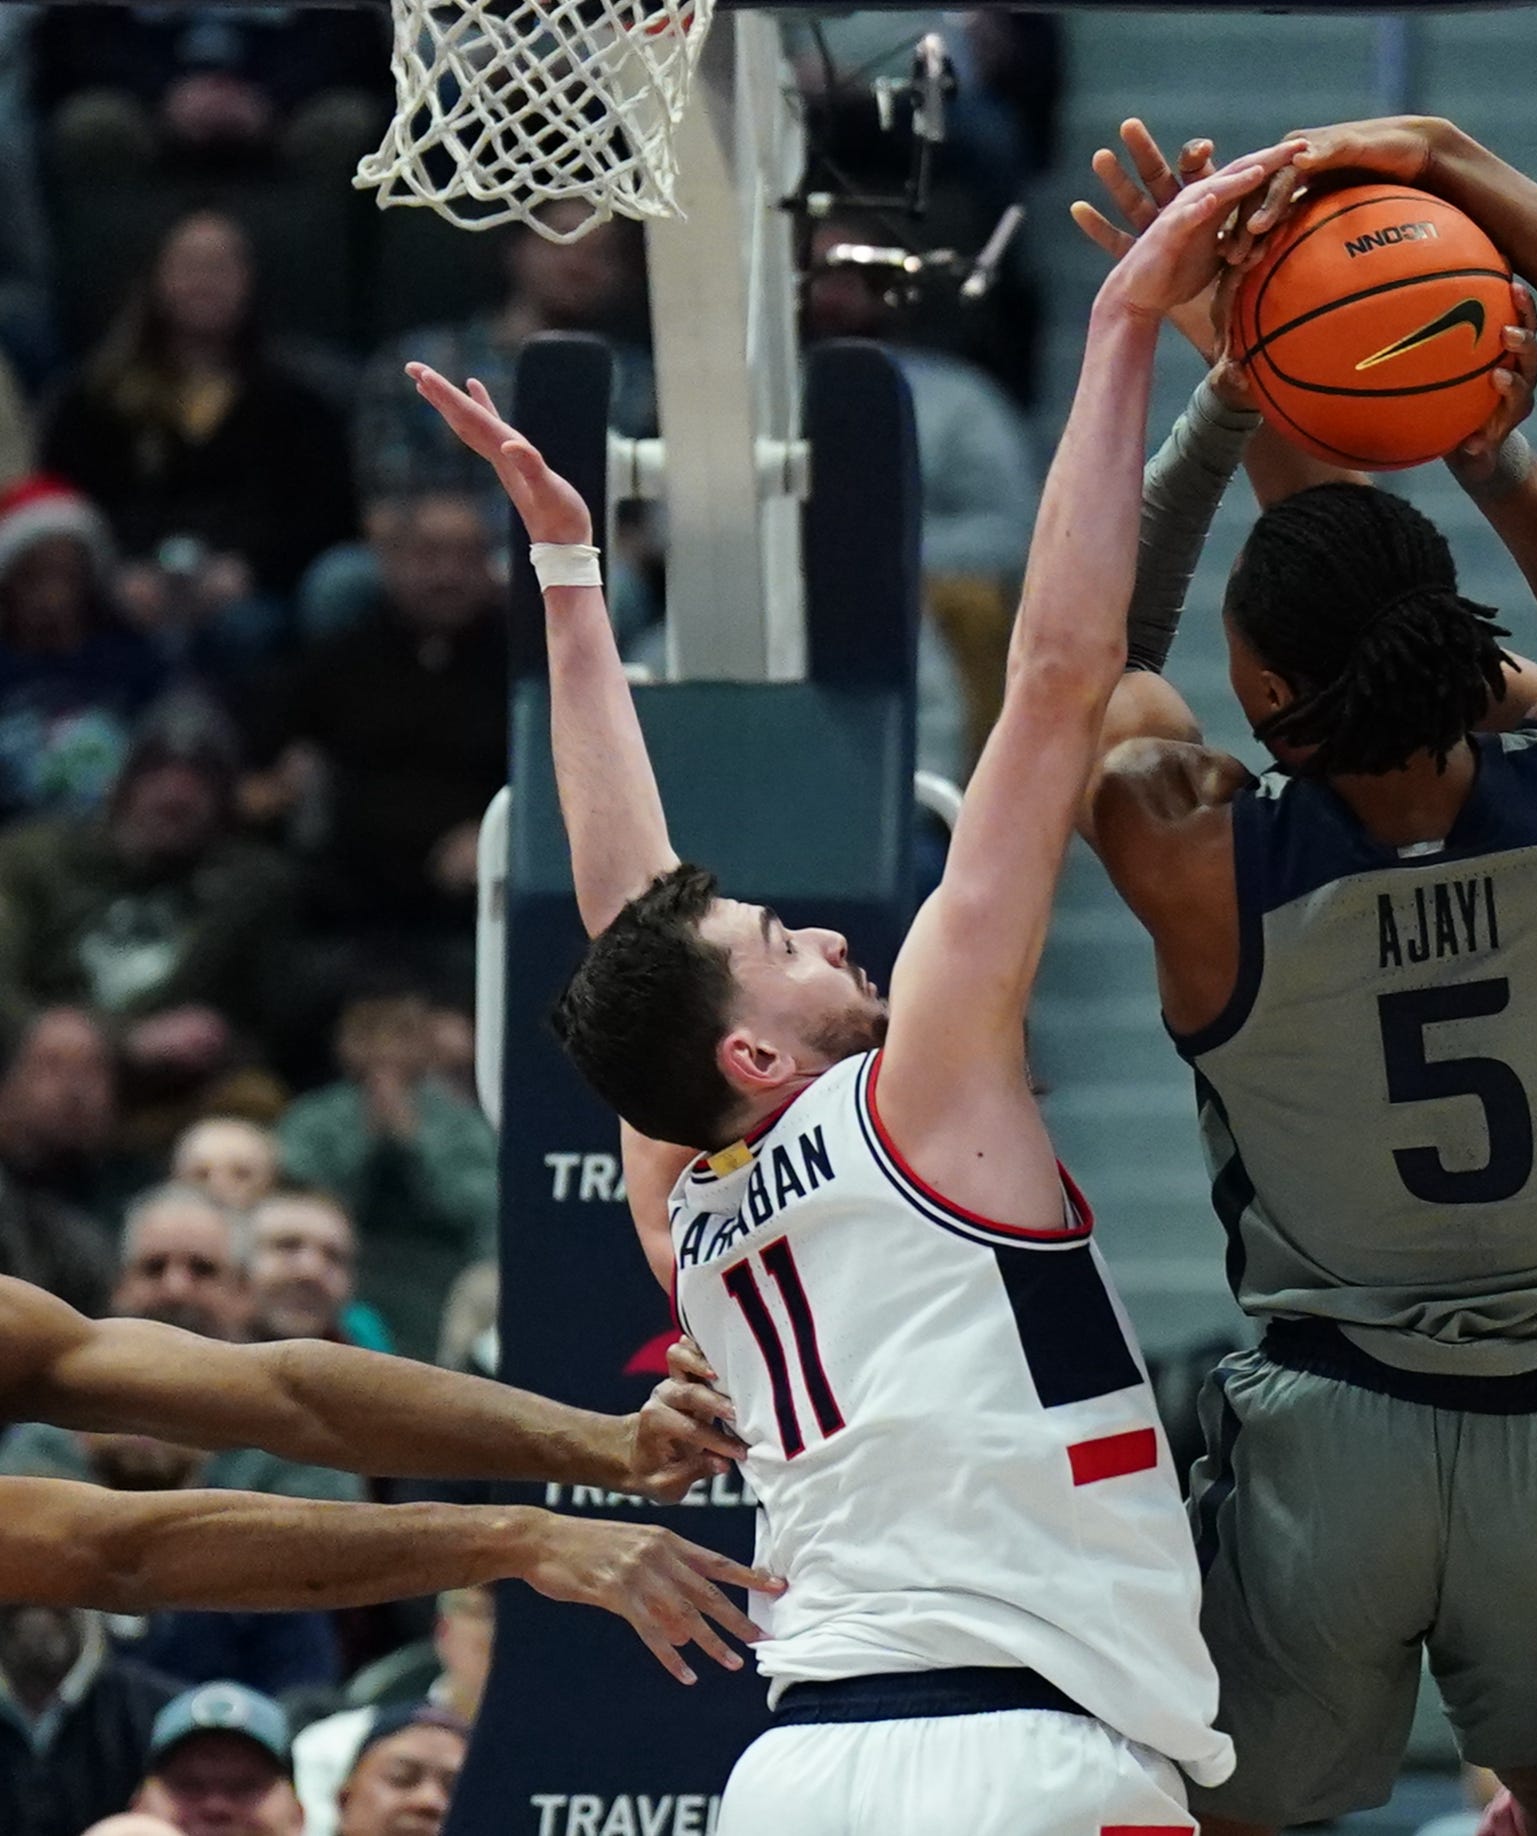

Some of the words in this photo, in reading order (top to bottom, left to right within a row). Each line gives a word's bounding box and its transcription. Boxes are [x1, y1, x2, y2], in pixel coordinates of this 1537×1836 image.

[1344, 221, 1439, 258] UCONN
[1377, 876, 1499, 968] AJAYI
[1377, 977, 1534, 1205] 5
[721, 1235, 847, 1462] 11
